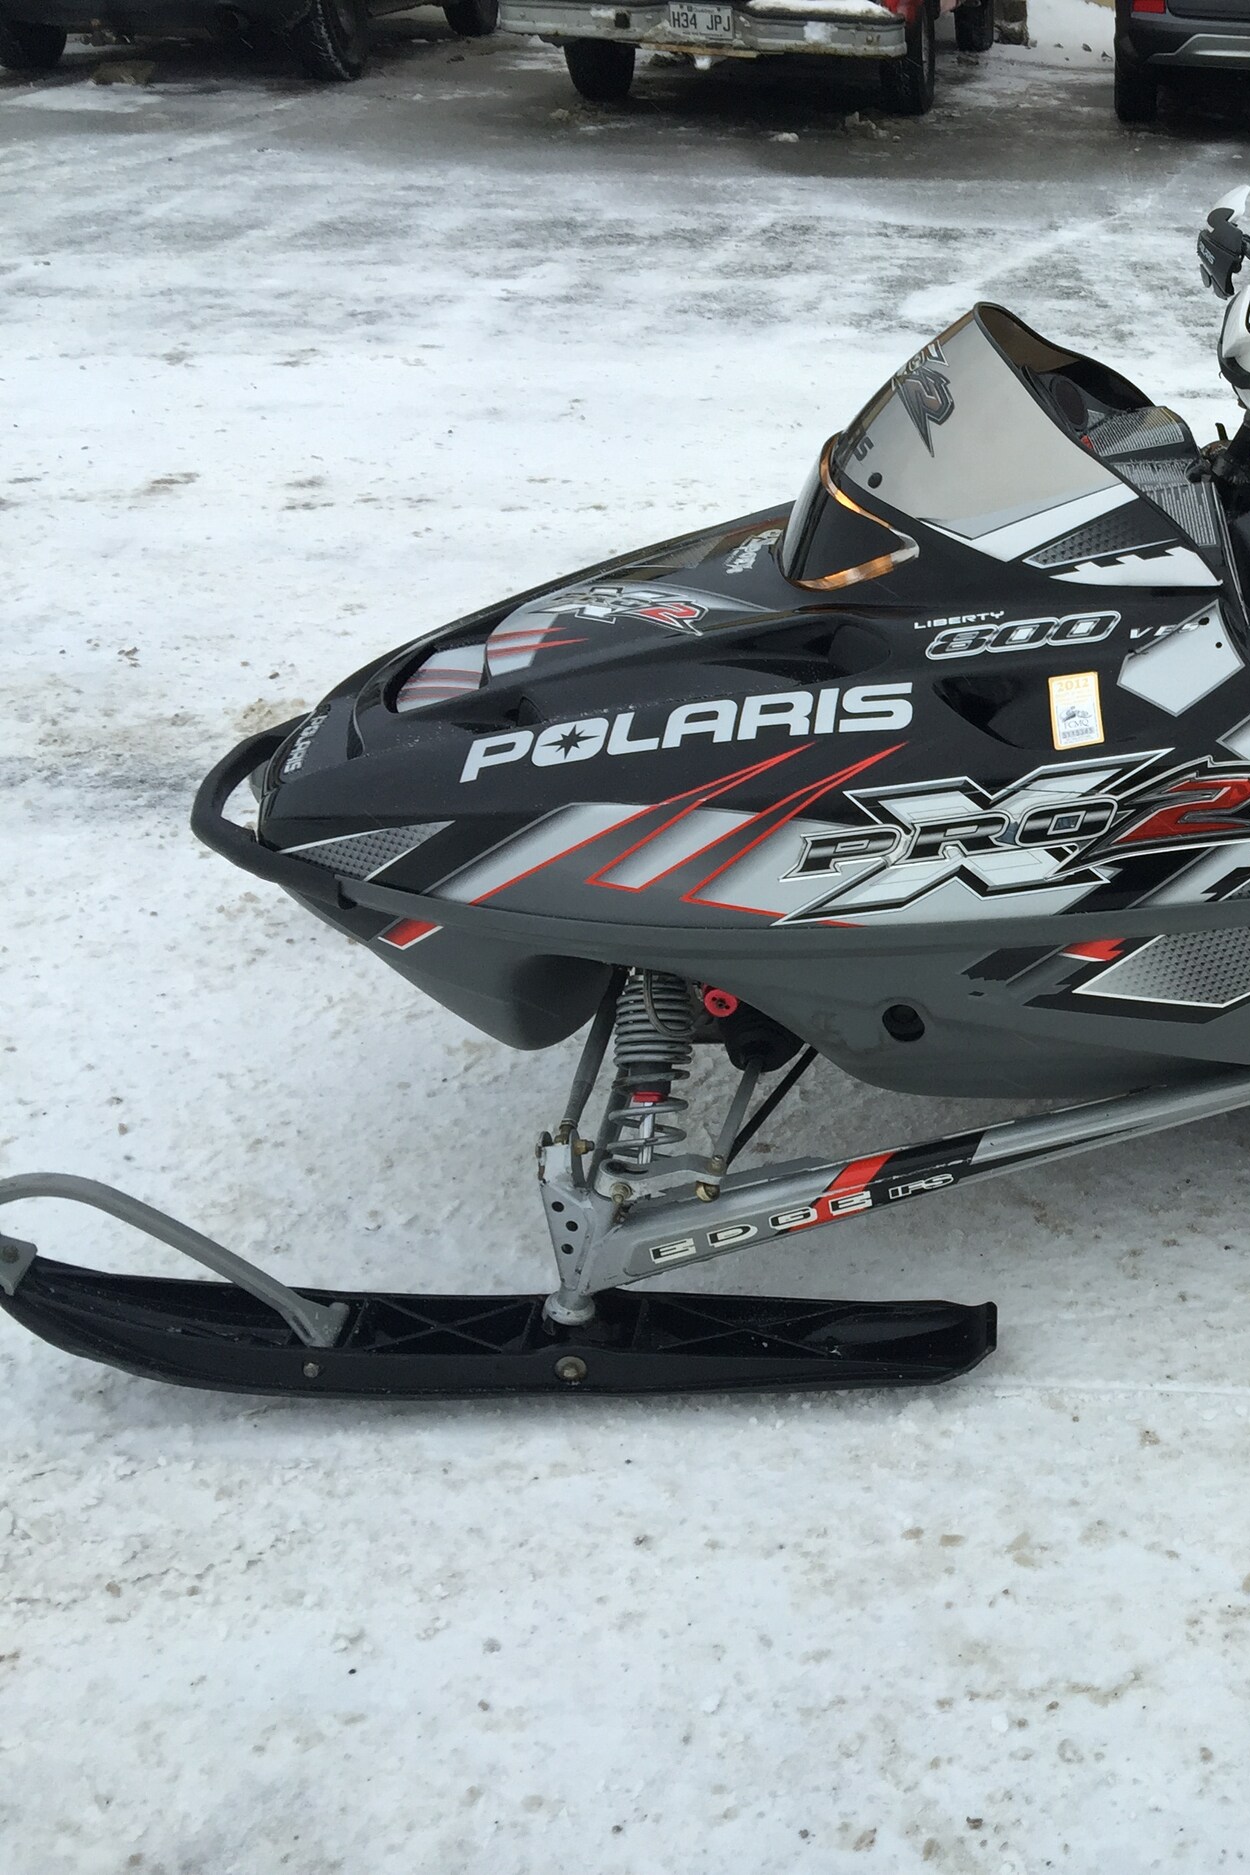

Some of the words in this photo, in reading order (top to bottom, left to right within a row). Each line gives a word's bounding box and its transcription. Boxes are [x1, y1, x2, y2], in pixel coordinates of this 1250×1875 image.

[672, 11, 697, 29] H34
[706, 14, 731, 32] JPJ
[913, 611, 1005, 629] LIBERTY
[925, 610, 1121, 661] 800
[1057, 678, 1090, 692] 2012
[283, 714, 328, 774] POLARIS
[460, 682, 914, 783] POLARIS
[649, 1190, 873, 1264] EDGE
[888, 1171, 955, 1200] IFS
